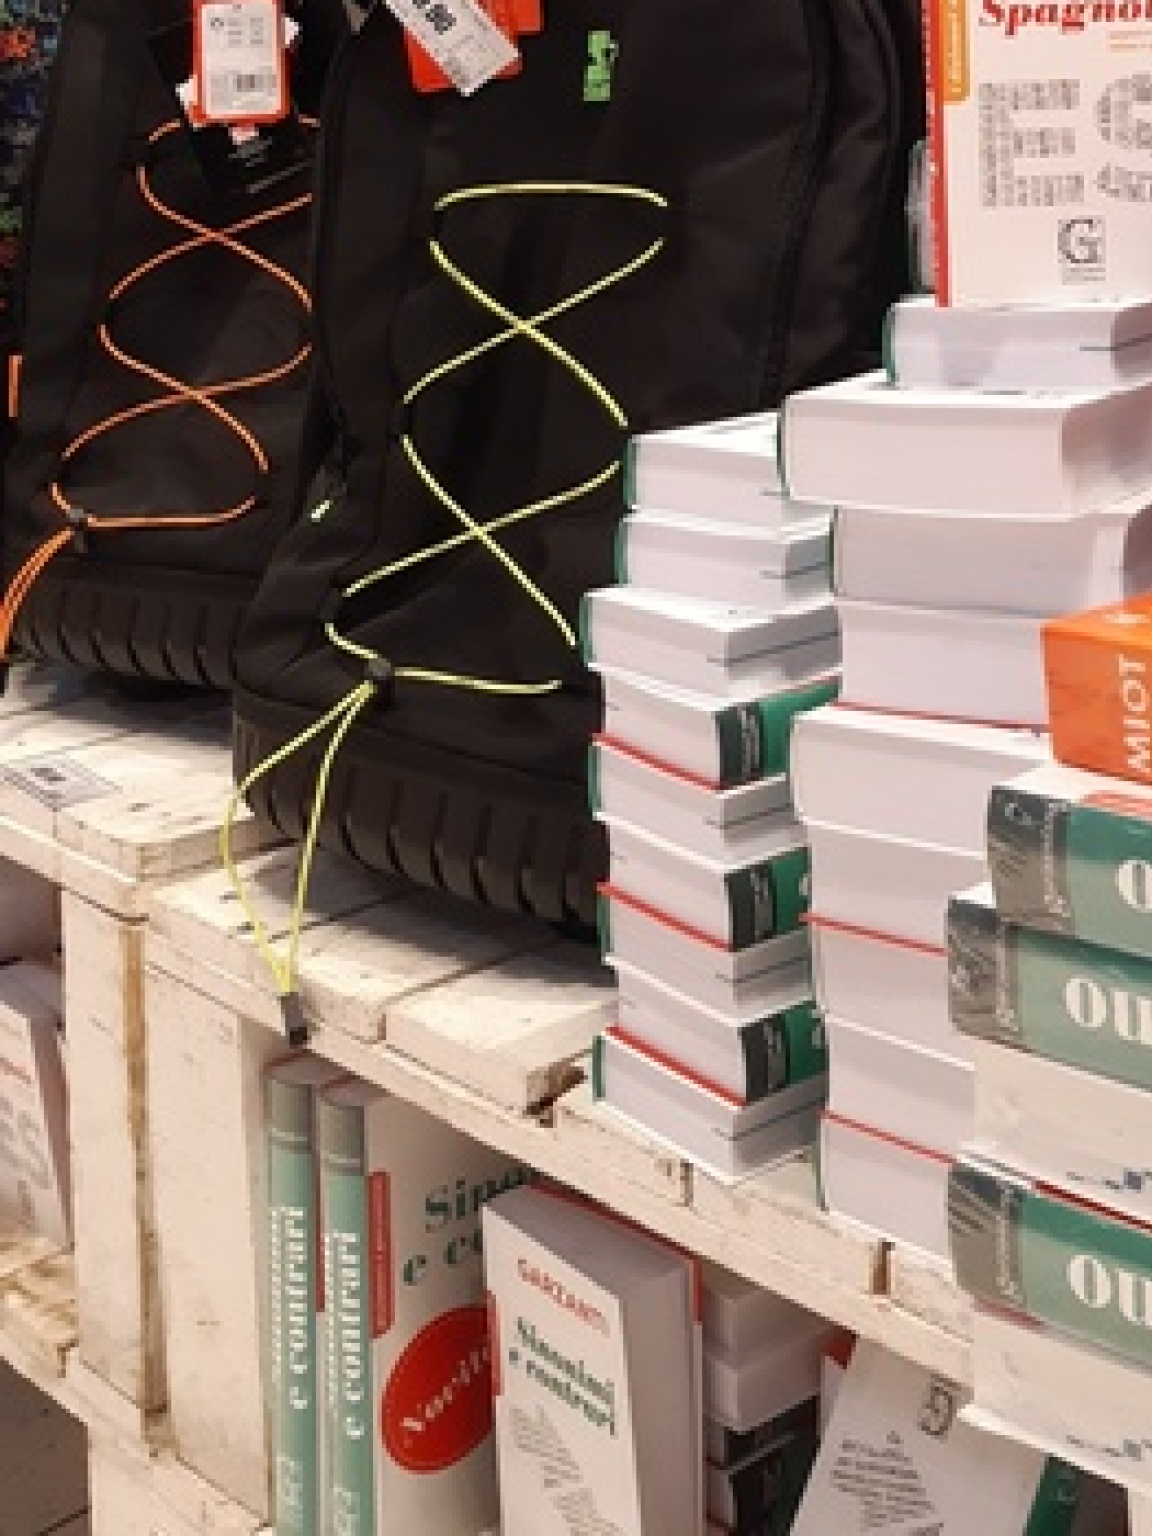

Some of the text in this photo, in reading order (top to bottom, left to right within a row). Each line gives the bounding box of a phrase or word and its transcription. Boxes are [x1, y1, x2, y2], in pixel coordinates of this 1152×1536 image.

[1118, 653, 1151, 776] MIOT
[403, 1252, 428, 1286] e
[287, 1385, 309, 1411] e
[340, 1413, 366, 1440] e
